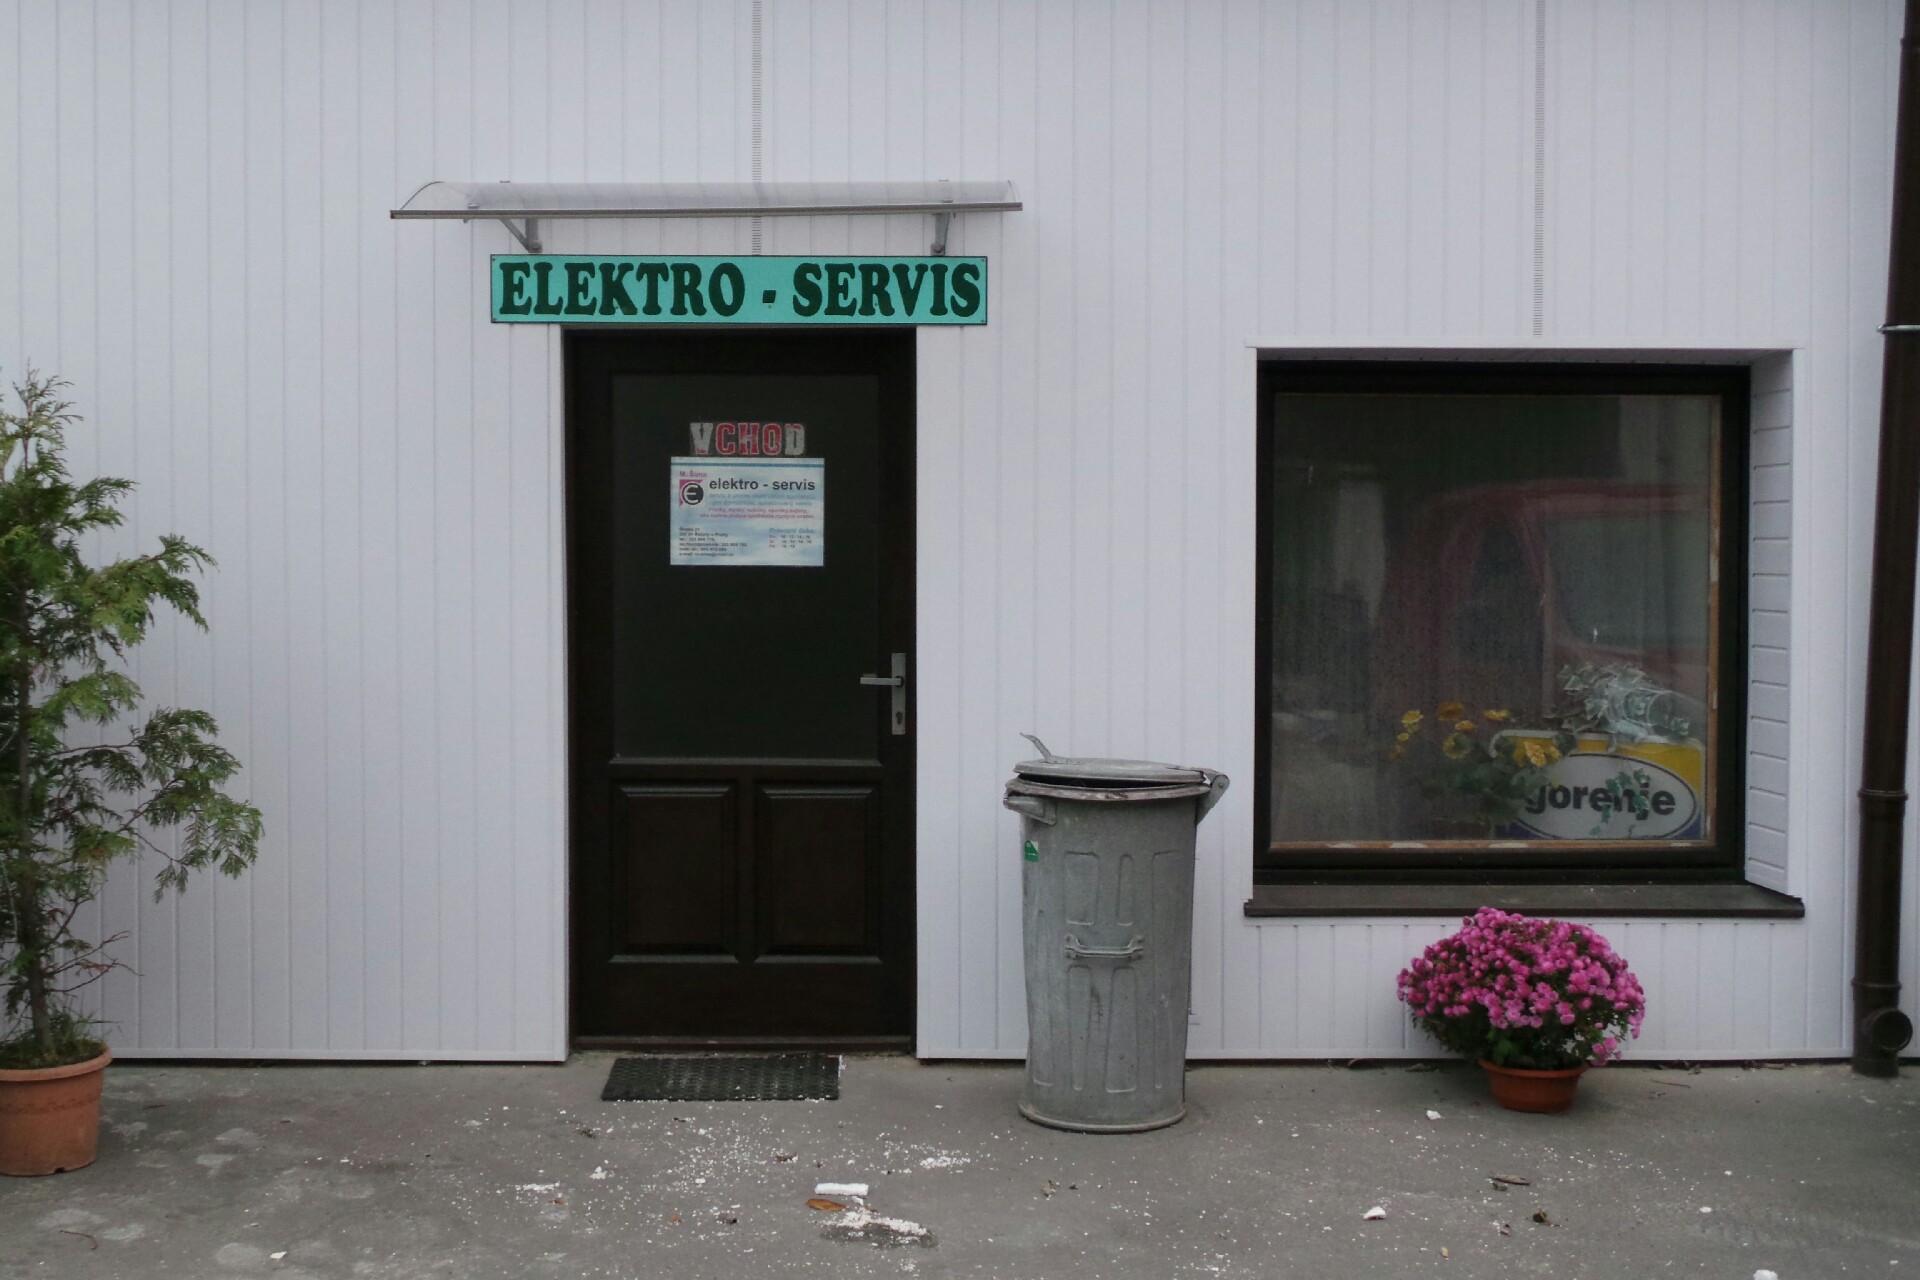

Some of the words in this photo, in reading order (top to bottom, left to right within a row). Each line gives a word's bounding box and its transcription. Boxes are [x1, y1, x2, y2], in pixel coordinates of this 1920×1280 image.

[499, 262, 746, 316] ELEKTRO
[793, 263, 981, 317] SERVIS
[690, 422, 805, 456] VCHOD
[709, 478, 759, 490] elektro
[772, 479, 816, 491] servis
